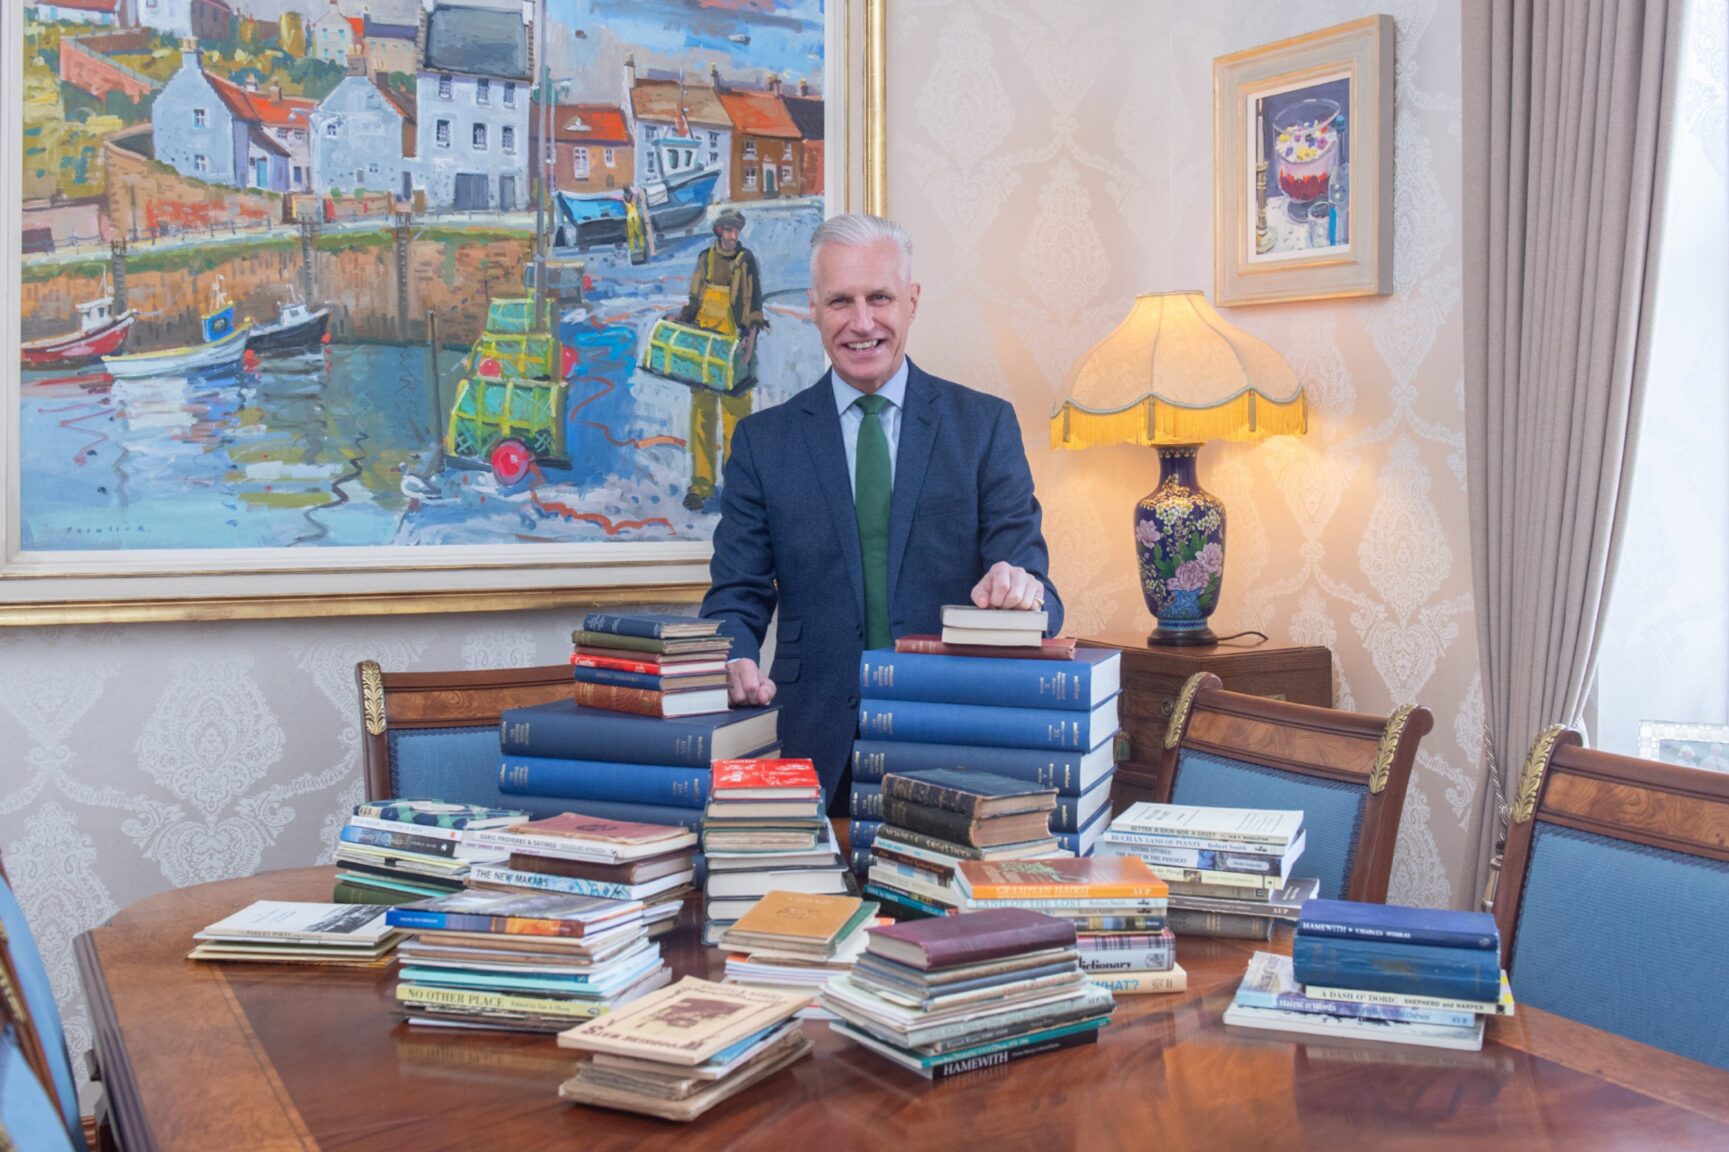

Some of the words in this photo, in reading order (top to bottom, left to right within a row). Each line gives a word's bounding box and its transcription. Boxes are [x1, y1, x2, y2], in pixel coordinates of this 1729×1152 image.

[497, 835, 527, 845] PROVERBS
[1111, 834, 1143, 843] BUCHAN
[1176, 839, 1201, 847] PLENTY
[475, 868, 493, 880] THE
[493, 871, 513, 884] NEW
[515, 874, 549, 888] MAKARS
[1302, 922, 1347, 934] HAMEWITH
[1355, 928, 1384, 936] CHARLES
[407, 988, 424, 999] NO
[426, 989, 465, 1004] OTHER
[468, 993, 504, 1008] PLACE
[1329, 991, 1354, 999] DASH
[1368, 994, 1396, 1004] DORIC
[1404, 998, 1440, 1008] SHEPHERD
[1456, 1003, 1484, 1011] HARPER
[943, 1050, 1009, 1076] HAMEWITH
